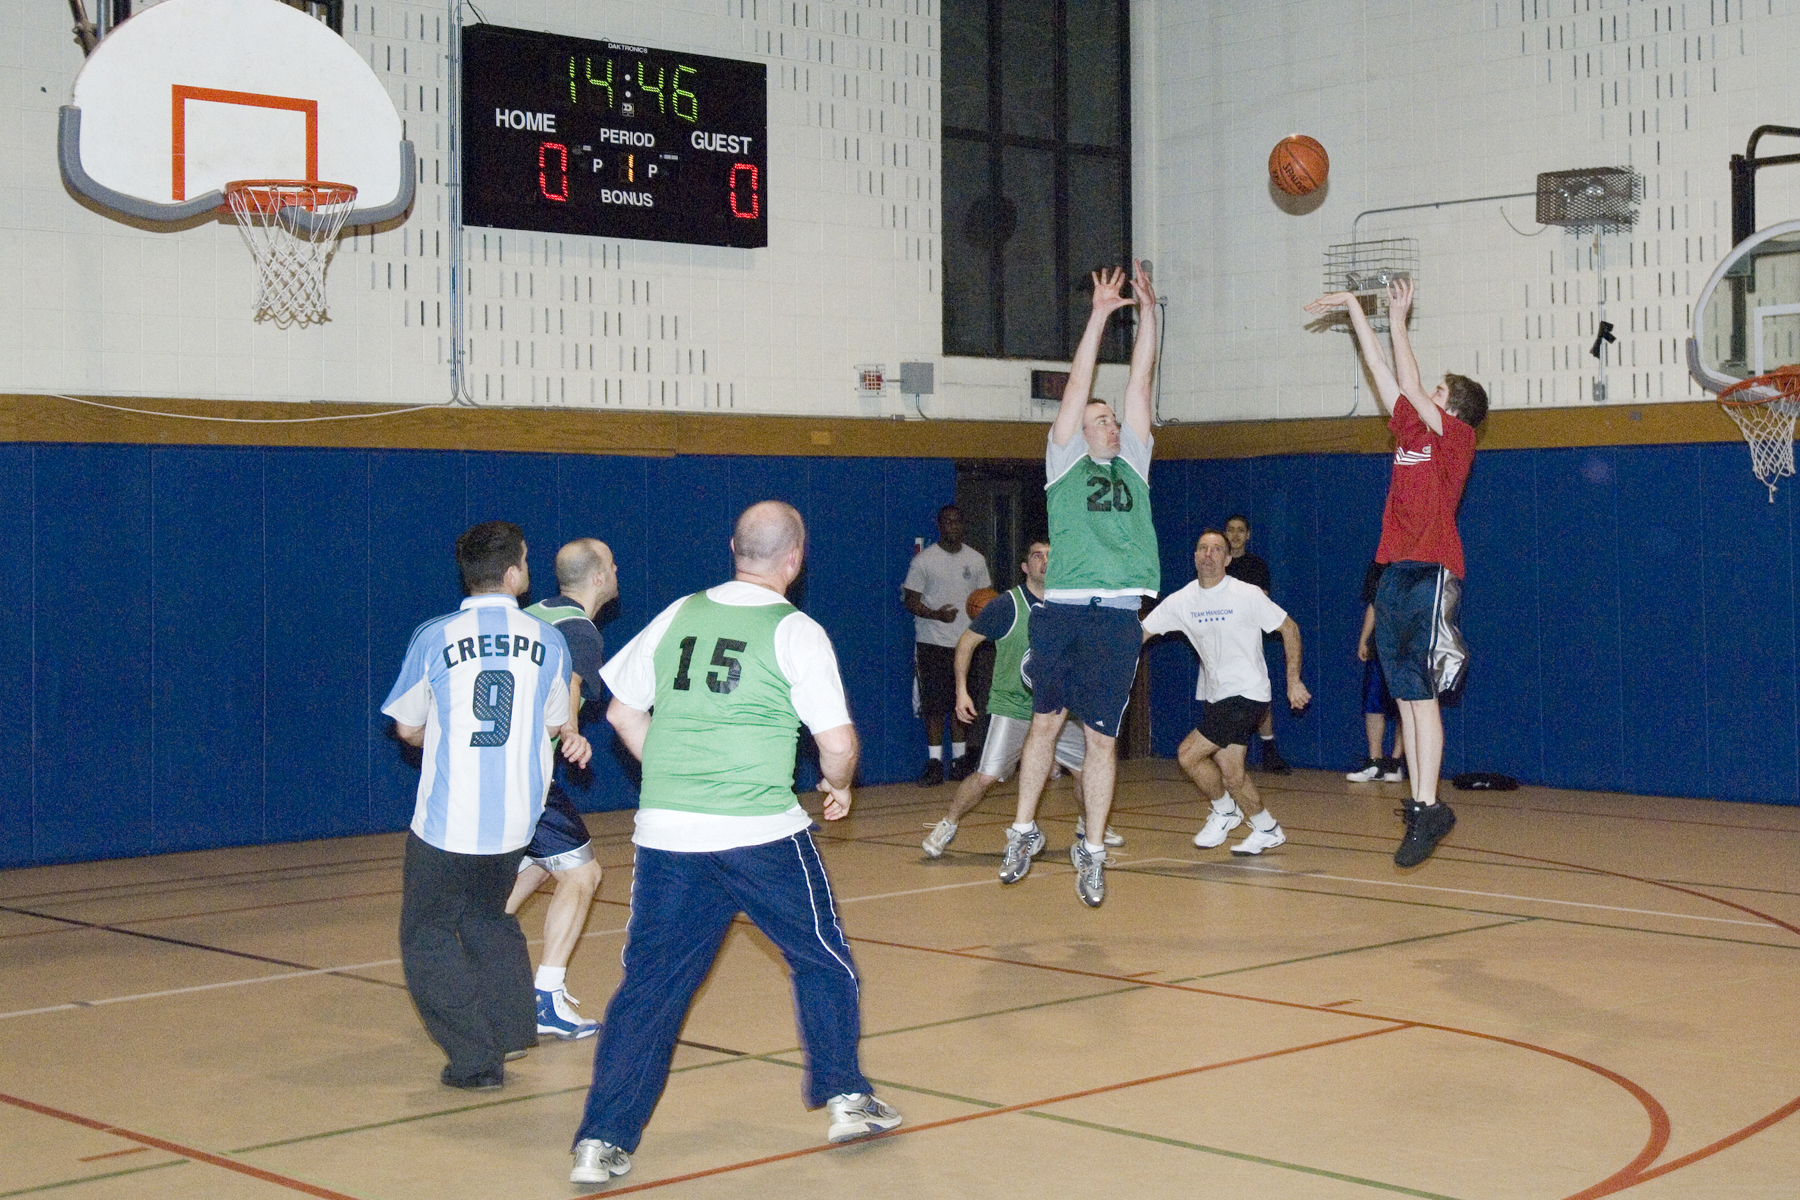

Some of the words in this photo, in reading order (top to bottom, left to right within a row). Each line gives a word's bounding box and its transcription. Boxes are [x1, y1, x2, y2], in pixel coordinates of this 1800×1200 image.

[607, 42, 648, 54] DAKTRONICS
[569, 56, 698, 123] 14:46
[495, 107, 557, 133] HOME
[600, 128, 655, 148] PERIOD
[691, 130, 753, 155] GUEST
[538, 141, 569, 202] 0
[593, 158, 603, 173] P
[628, 153, 634, 183] 1
[648, 163, 658, 178] P
[600, 188, 654, 208] BONUS
[729, 162, 759, 220] 0
[1086, 475, 1134, 513] 20
[442, 634, 547, 669] CRESPO
[672, 635, 748, 695] 15
[469, 669, 516, 748] 9
